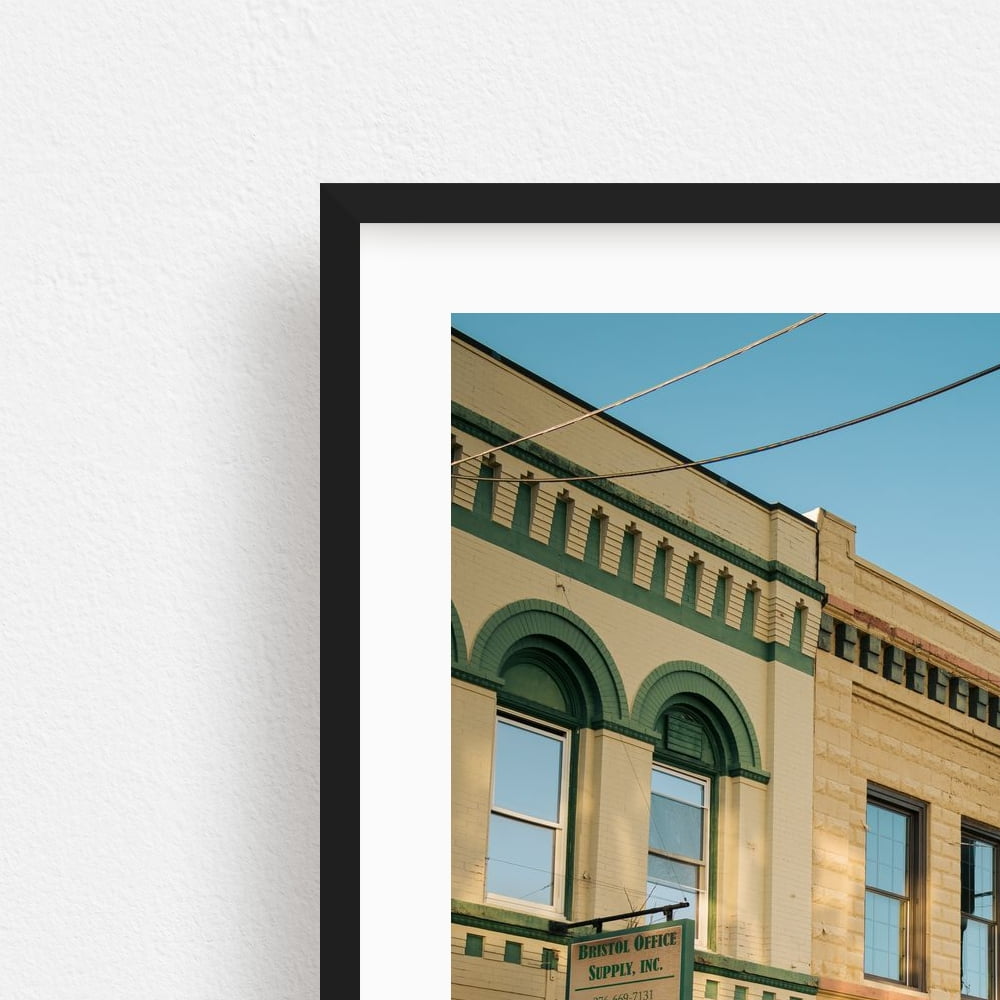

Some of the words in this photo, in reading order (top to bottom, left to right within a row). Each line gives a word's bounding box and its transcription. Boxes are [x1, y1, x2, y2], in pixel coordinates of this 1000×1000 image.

[578, 940, 630, 960] BRISTOL
[634, 932, 678, 948] OFFICE
[588, 961, 636, 981] SUPPLY,
[640, 957, 663, 974] INC.
